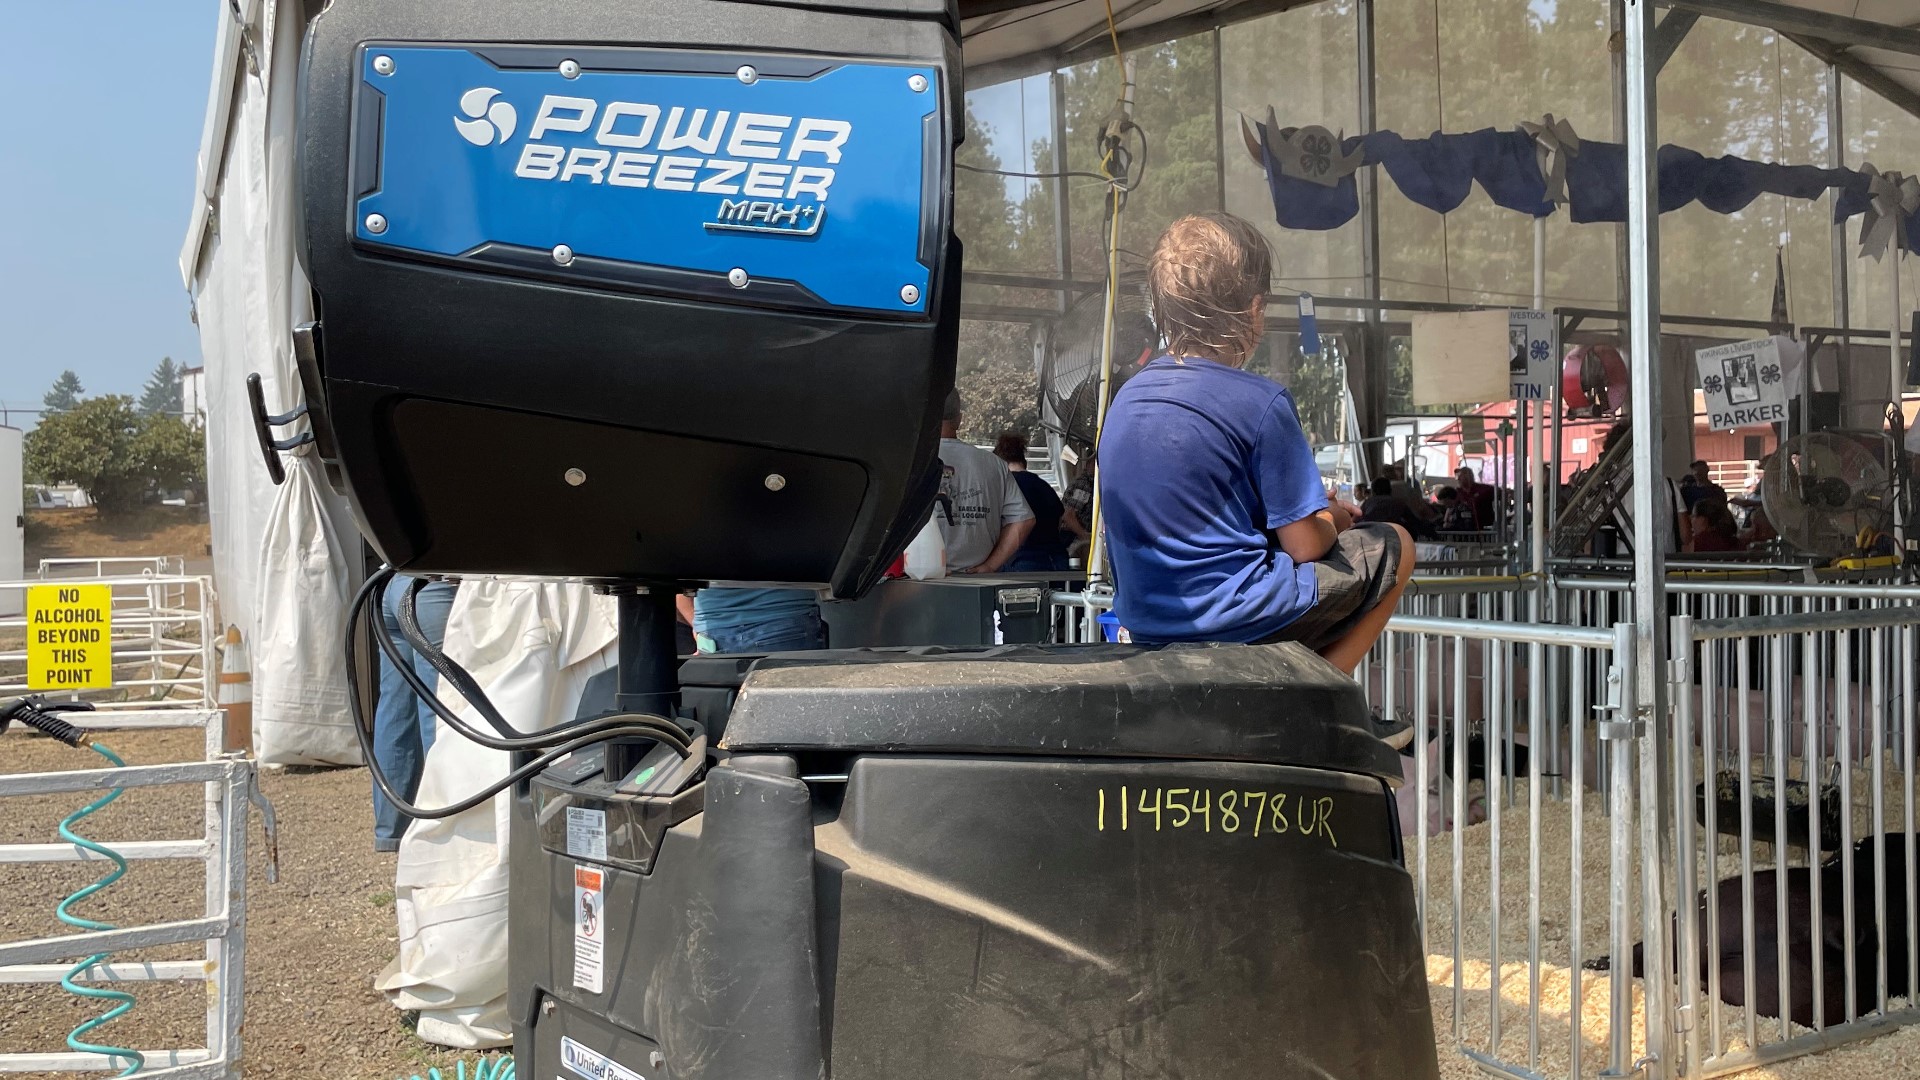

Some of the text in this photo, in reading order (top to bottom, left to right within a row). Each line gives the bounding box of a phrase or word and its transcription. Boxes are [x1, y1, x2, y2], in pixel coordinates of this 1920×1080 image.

[528, 94, 852, 164] POWER
[514, 144, 836, 202] BREEZER
[1510, 311, 1546, 320] IVESTOCK
[1700, 339, 1774, 359] VIKINGS LIVESTOCK
[1510, 383, 1542, 399] TIN
[1712, 404, 1785, 428] PARKER
[58, 588, 80, 603] NO
[34, 608, 104, 624] ALCOHOL
[38, 628, 100, 644] BEYOND
[52, 649, 87, 664] THIS
[46, 668, 93, 684] POINT
[577, 1050, 606, 1079] United
